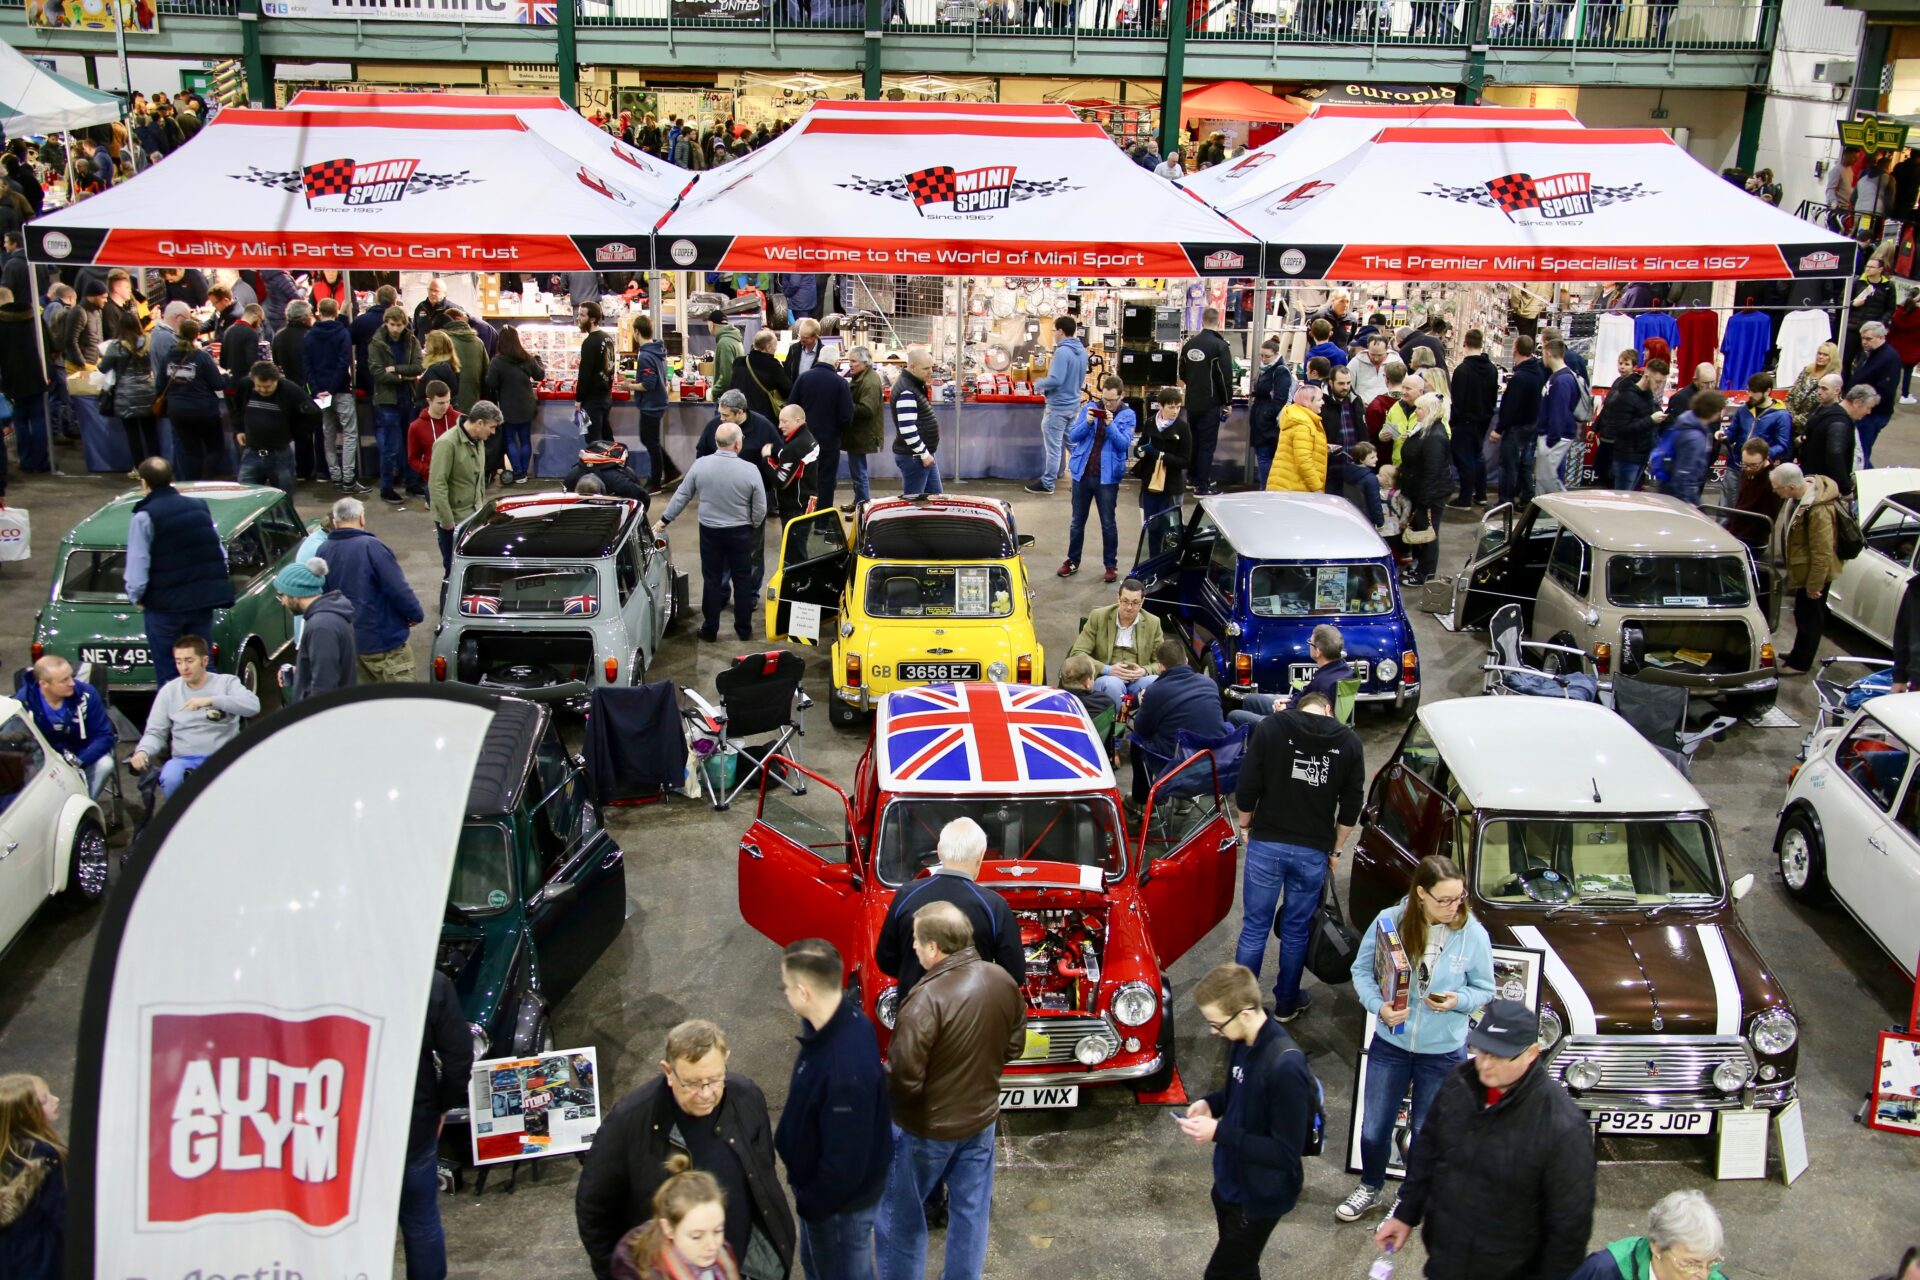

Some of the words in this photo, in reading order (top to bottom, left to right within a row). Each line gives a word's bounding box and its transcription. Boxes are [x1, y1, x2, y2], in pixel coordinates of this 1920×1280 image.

[721, 2, 760, 11] UNITED
[352, 160, 413, 185] MINI
[955, 168, 1010, 192] MINI
[347, 181, 406, 204] SPORT
[1534, 174, 1586, 199] MINI
[957, 188, 1008, 212] SPORT
[1541, 194, 1591, 218] SPORT
[158, 241, 236, 260] Quality
[242, 242, 287, 257] Mini
[293, 243, 354, 258] Parts
[360, 243, 402, 258] You
[408, 244, 453, 258] Can
[457, 244, 519, 260] Trust
[674, 248, 694, 257] COOPER
[764, 246, 861, 261] Welcome
[867, 248, 888, 262] to
[895, 248, 931, 263] the
[936, 249, 1000, 264] World
[1005, 249, 1029, 264] of
[1034, 251, 1077, 265] Mini
[1082, 252, 1145, 268] Sport
[1219, 252, 1229, 260] 37
[1816, 253, 1825, 261] 37
[1283, 257, 1303, 266] COOPER
[1361, 256, 1402, 269] The
[1408, 256, 1488, 270] Premier
[1493, 256, 1535, 270] Mini
[1541, 256, 1638, 272] Specialist
[1644, 257, 1699, 270] Since
[1703, 256, 1750, 270] 1967
[82, 648, 118, 664] NEY
[872, 665, 891, 678] GB
[906, 665, 947, 679] 3656
[950, 665, 971, 678] EZ
[171, 1056, 344, 1127] AUTO
[1033, 1088, 1072, 1105] VNX
[1598, 1112, 1653, 1130] P925
[1660, 1113, 1701, 1130] JOP
[169, 1112, 339, 1183] GLYM
